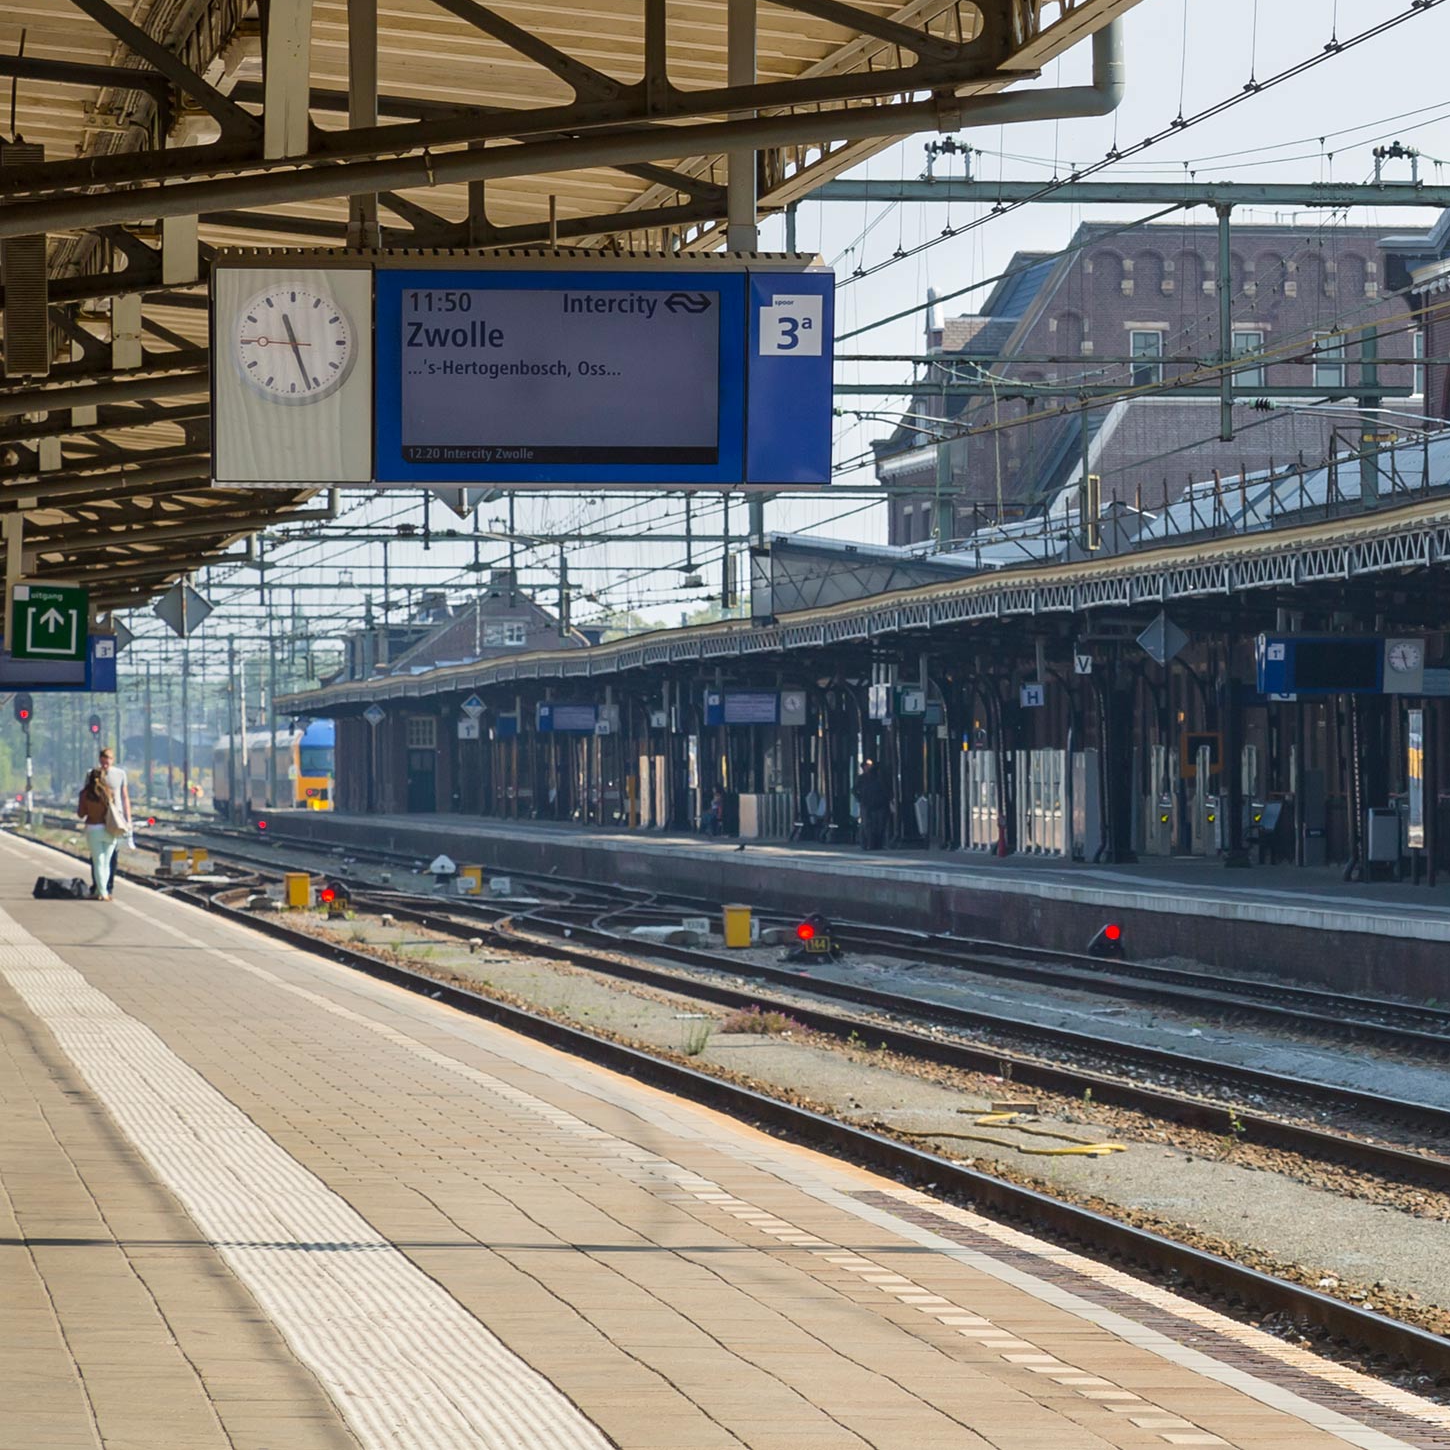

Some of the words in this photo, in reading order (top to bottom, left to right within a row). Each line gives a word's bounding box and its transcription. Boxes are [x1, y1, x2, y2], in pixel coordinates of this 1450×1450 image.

[410, 292, 472, 312] 11:50
[563, 293, 658, 319] Intercity
[407, 321, 505, 348] Zwolle
[578, 361, 622, 376] Oss...
[444, 448, 492, 462] Intercity
[496, 448, 534, 459] Zwolle
[31, 592, 63, 602] uitgang
[912, 699, 918, 710] J
[1027, 690, 1039, 705] H
